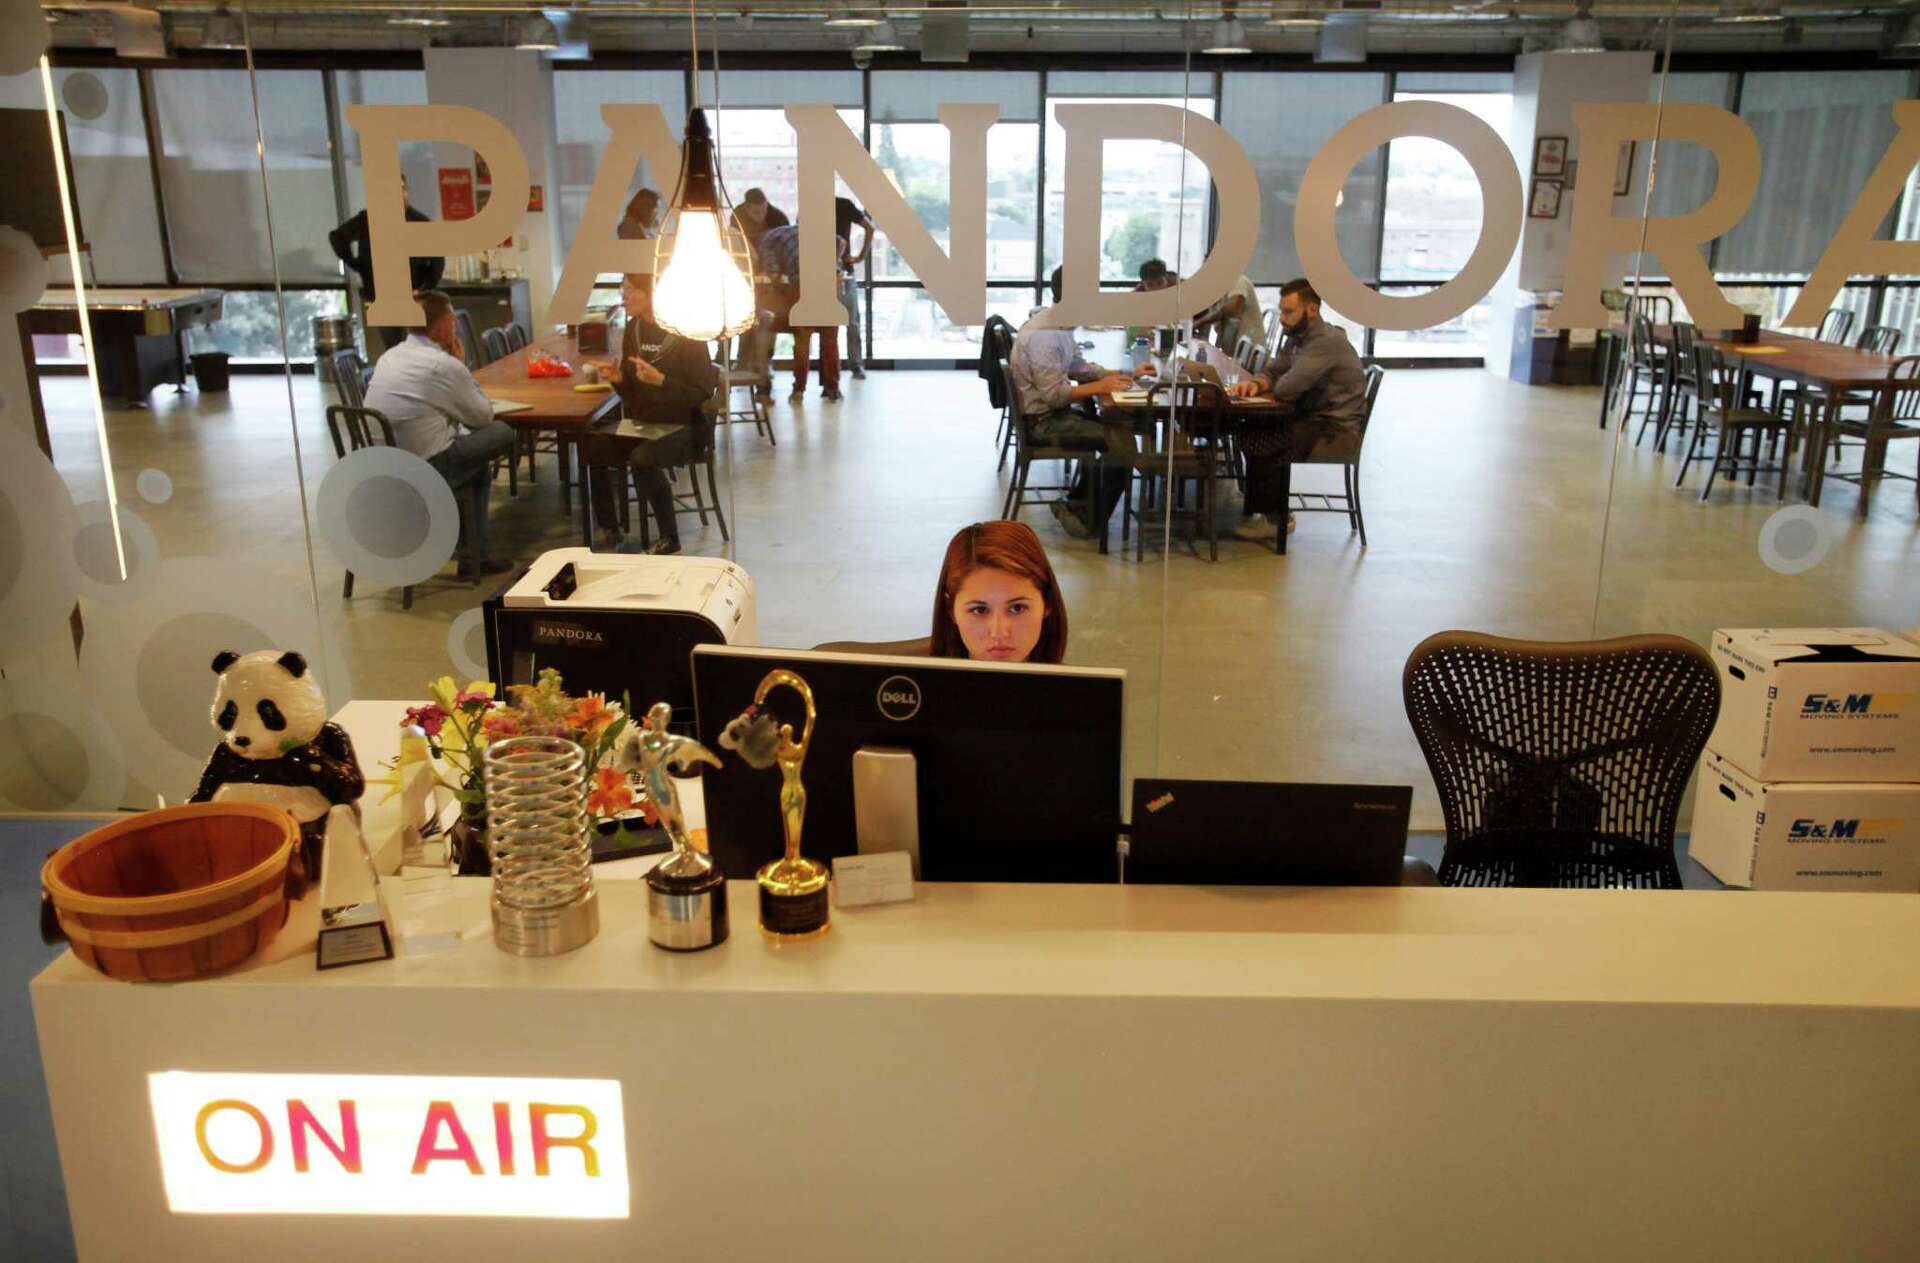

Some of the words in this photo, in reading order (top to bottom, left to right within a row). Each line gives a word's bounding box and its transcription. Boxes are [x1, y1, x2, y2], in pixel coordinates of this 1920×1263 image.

[539, 626, 603, 641] PANDORA
[882, 691, 916, 704] DELL
[1801, 693, 1873, 713] S&M
[1789, 819, 1860, 837] S&M
[195, 1098, 362, 1174] ON
[411, 1101, 601, 1177] AIR
